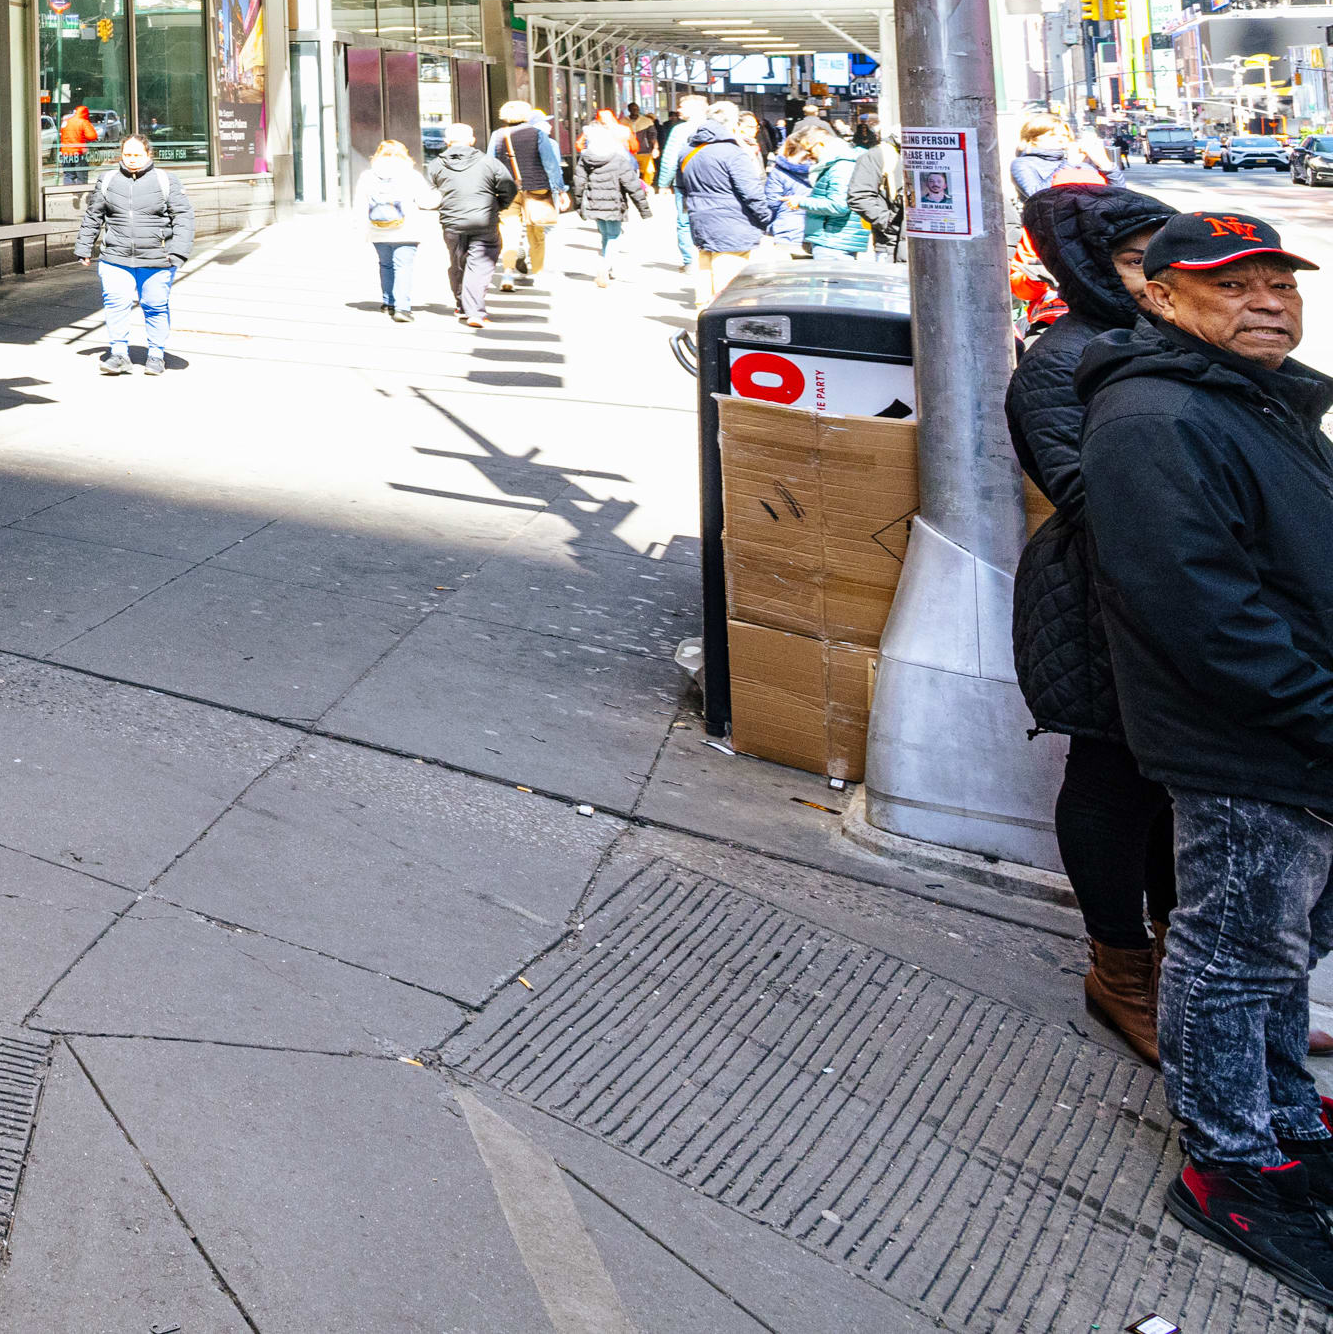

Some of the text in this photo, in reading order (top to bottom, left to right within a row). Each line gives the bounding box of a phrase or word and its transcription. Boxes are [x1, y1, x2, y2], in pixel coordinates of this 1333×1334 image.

[921, 135, 957, 146] PERSON
[58, 151, 80, 164] CRAB
[158, 148, 187, 160] FRESH FISH
[924, 150, 946, 161] HELP
[816, 369, 826, 400] PARTY
